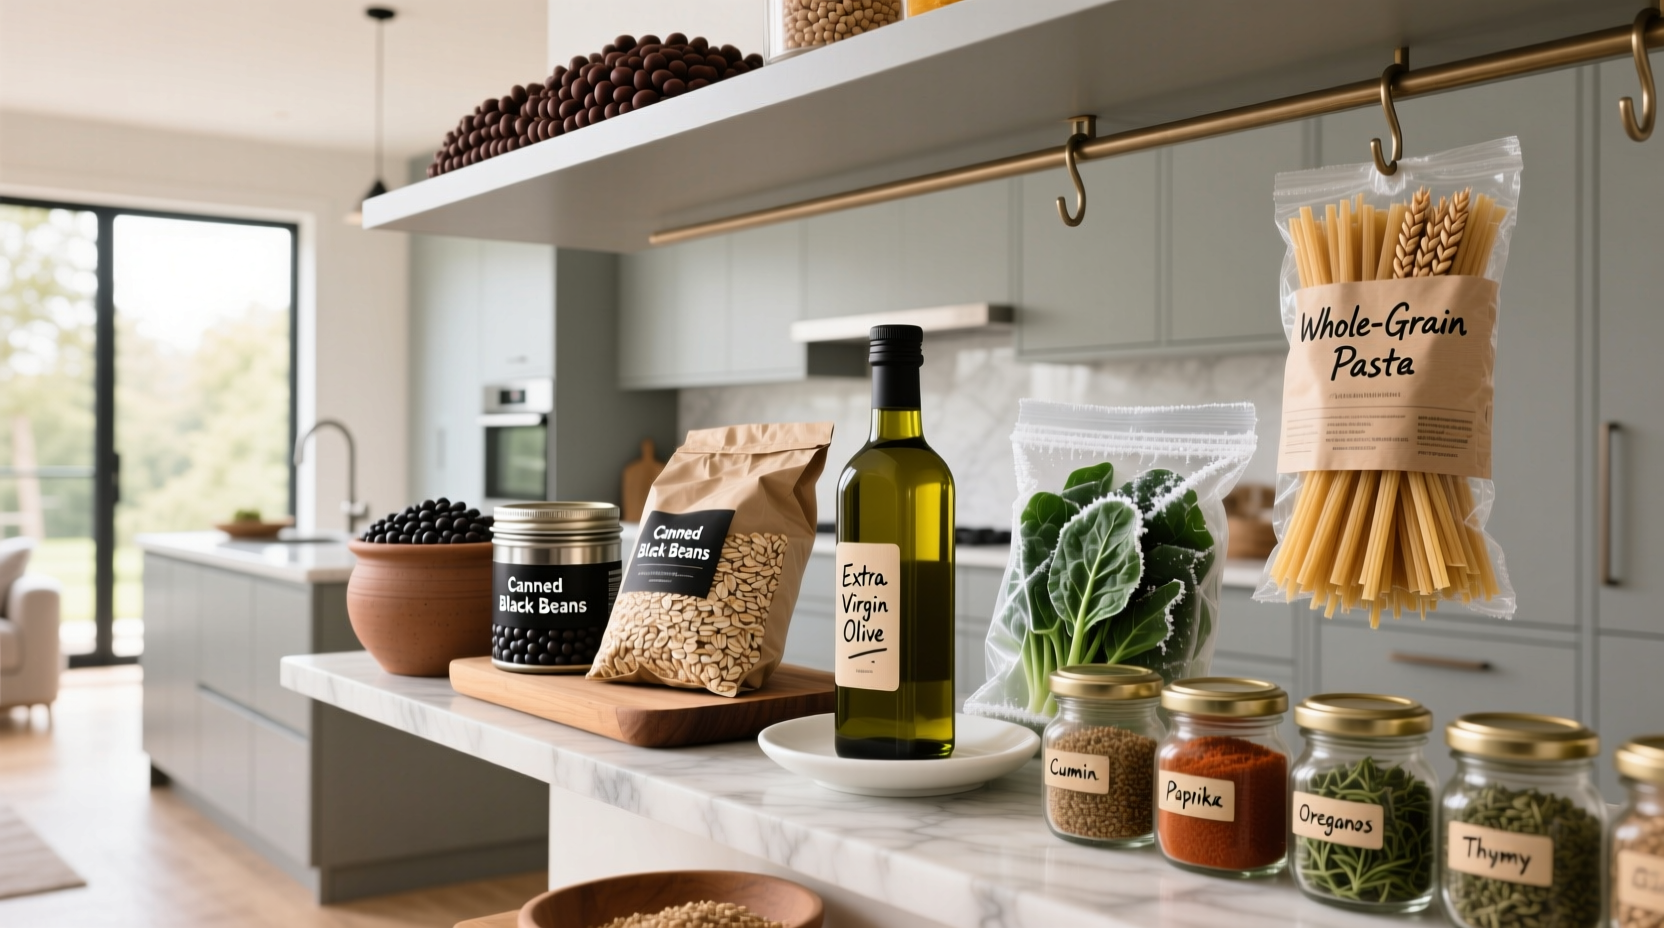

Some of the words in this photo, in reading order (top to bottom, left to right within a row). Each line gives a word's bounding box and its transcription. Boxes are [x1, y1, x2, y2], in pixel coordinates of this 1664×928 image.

[1301, 302, 1467, 342] Whole-Grain
[1331, 345, 1415, 381] Pasta
[654, 525, 704, 540] Canned
[668, 543, 710, 560] Beans
[508, 576, 563, 593] Canned
[842, 563, 888, 587] Extra
[499, 595, 534, 613] Black
[538, 597, 587, 614] Beans
[842, 592, 889, 622] Virgin
[843, 619, 884, 642] Olive
[1050, 758, 1099, 781] Cumin
[1299, 803, 1373, 836] Oreganos
[1463, 836, 1531, 876] Thymy
